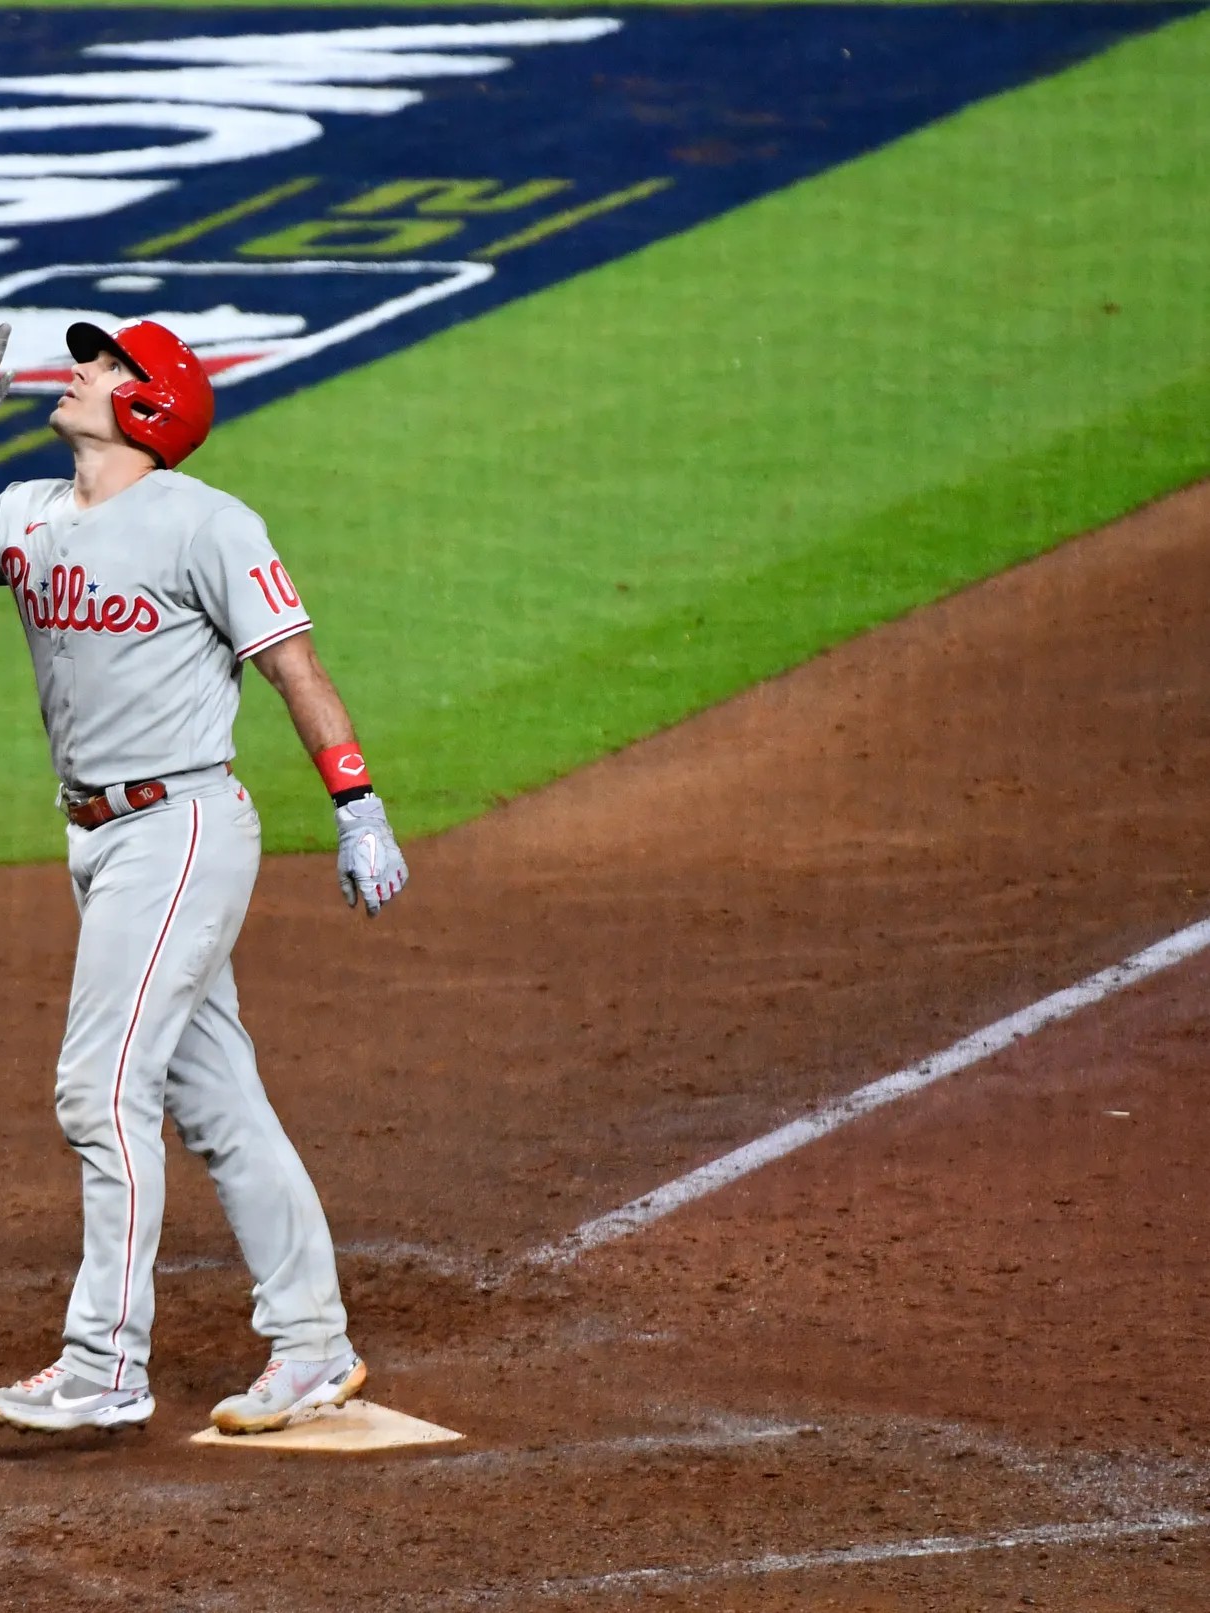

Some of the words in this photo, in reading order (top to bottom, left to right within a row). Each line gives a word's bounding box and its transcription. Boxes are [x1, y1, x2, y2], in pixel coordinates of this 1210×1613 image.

[235, 179, 575, 257] 20
[0, 545, 161, 635] Phillies
[248, 558, 300, 615] 10
[138, 787, 154, 800] 10
